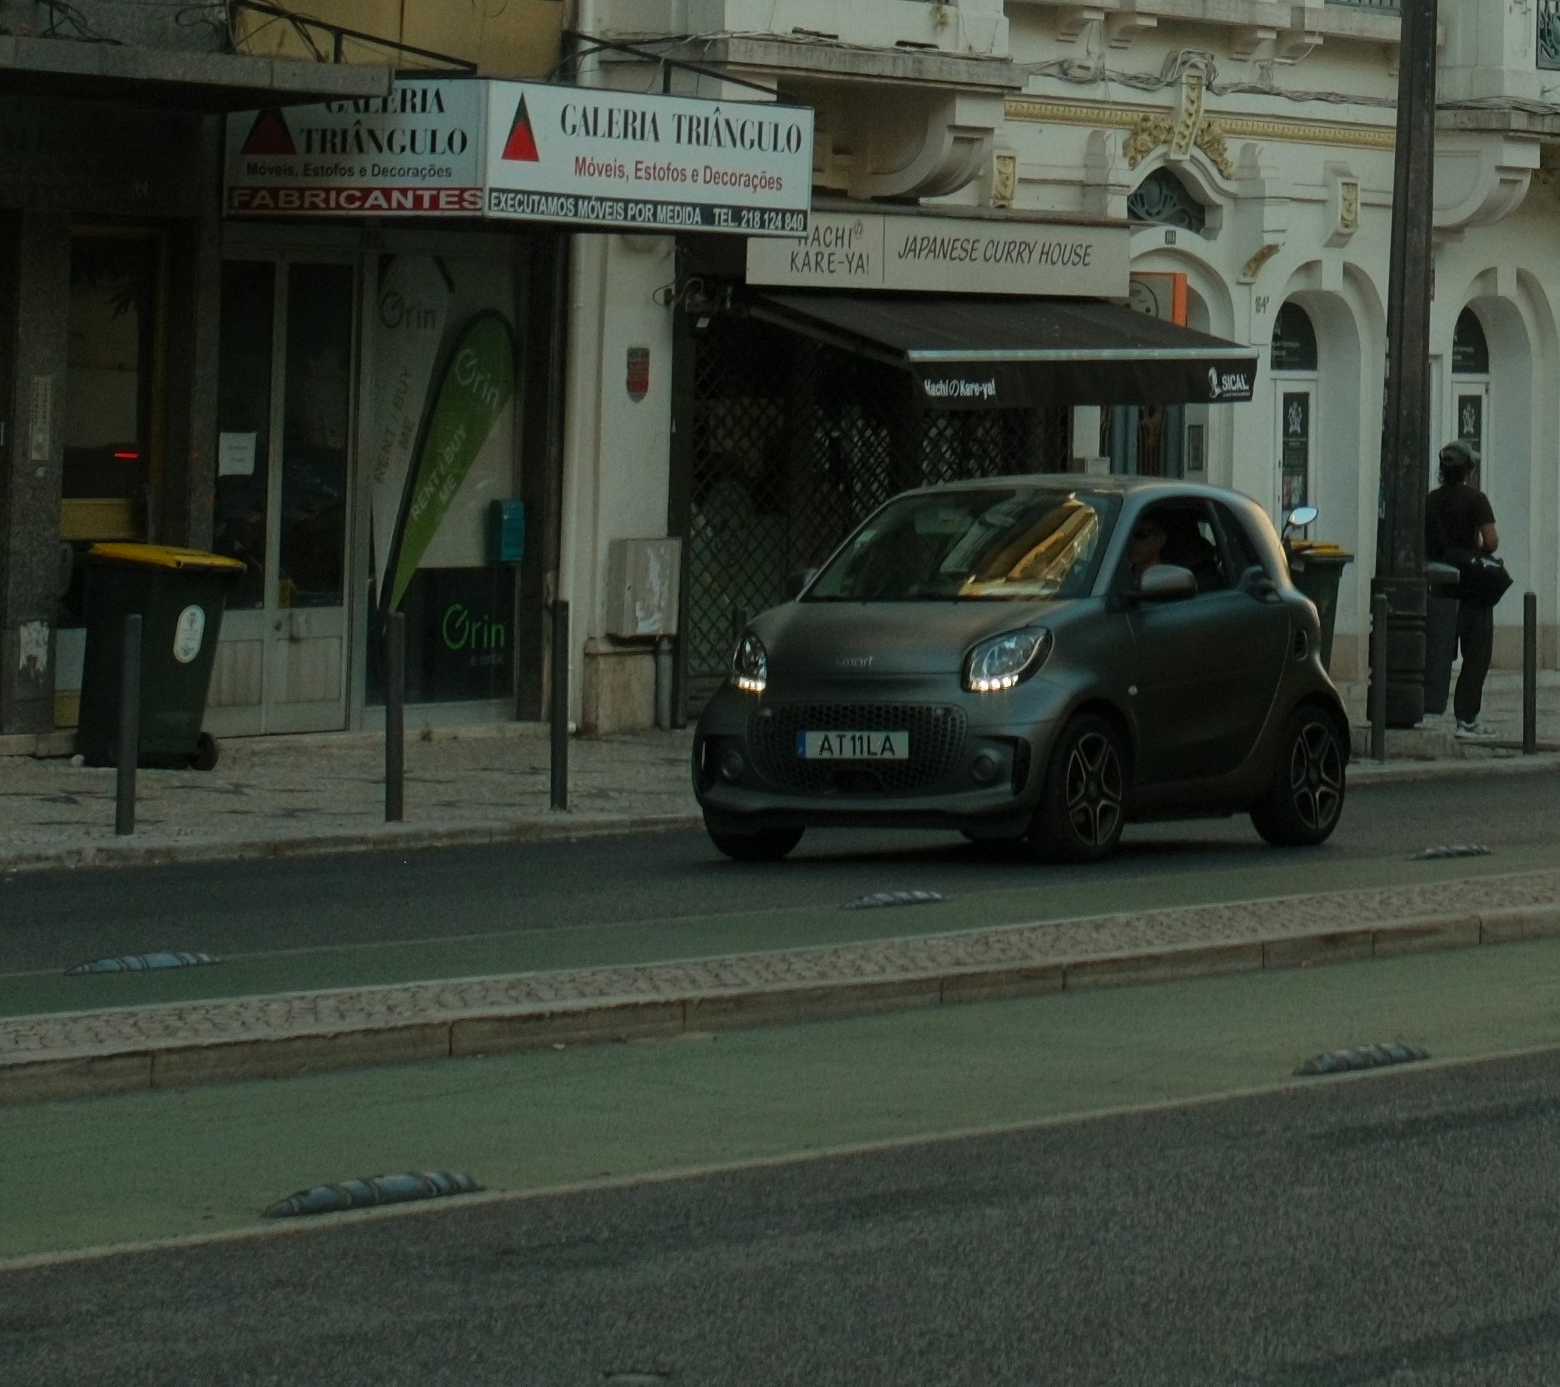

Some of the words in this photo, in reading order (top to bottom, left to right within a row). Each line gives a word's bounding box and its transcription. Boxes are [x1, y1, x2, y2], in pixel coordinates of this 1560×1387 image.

[325, 88, 445, 114] GALERIA
[300, 119, 468, 156] TRIÂNGULO
[561, 103, 660, 143] GALERIA
[672, 106, 802, 155] TRIÂNGULO
[246, 161, 299, 178] Móveis,
[303, 163, 355, 178] Estofos
[359, 166, 367, 178] e
[371, 164, 453, 181] Decorações
[574, 156, 629, 183] Móveis,
[634, 160, 687, 183] Estofos
[691, 168, 700, 183] e
[703, 165, 783, 193] Decorações
[231, 188, 483, 211] FABRICANTES
[490, 191, 575, 218] EXECUTAMOS
[578, 196, 625, 221] MÓVEIS
[627, 201, 655, 223] POR
[657, 205, 702, 225] MEDIDA
[713, 209, 738, 227] TEL.
[741, 210, 761, 229] 218
[763, 212, 783, 229] 124
[784, 213, 804, 232] 840
[898, 235, 981, 261] JAPANESE
[983, 239, 1037, 265] CURRY
[1040, 242, 1093, 267] HOUSE
[1221, 373, 1249, 391] SICAL
[410, 469, 440, 520] RENT
[443, 423, 466, 465] BUY
[439, 473, 457, 504] ME
